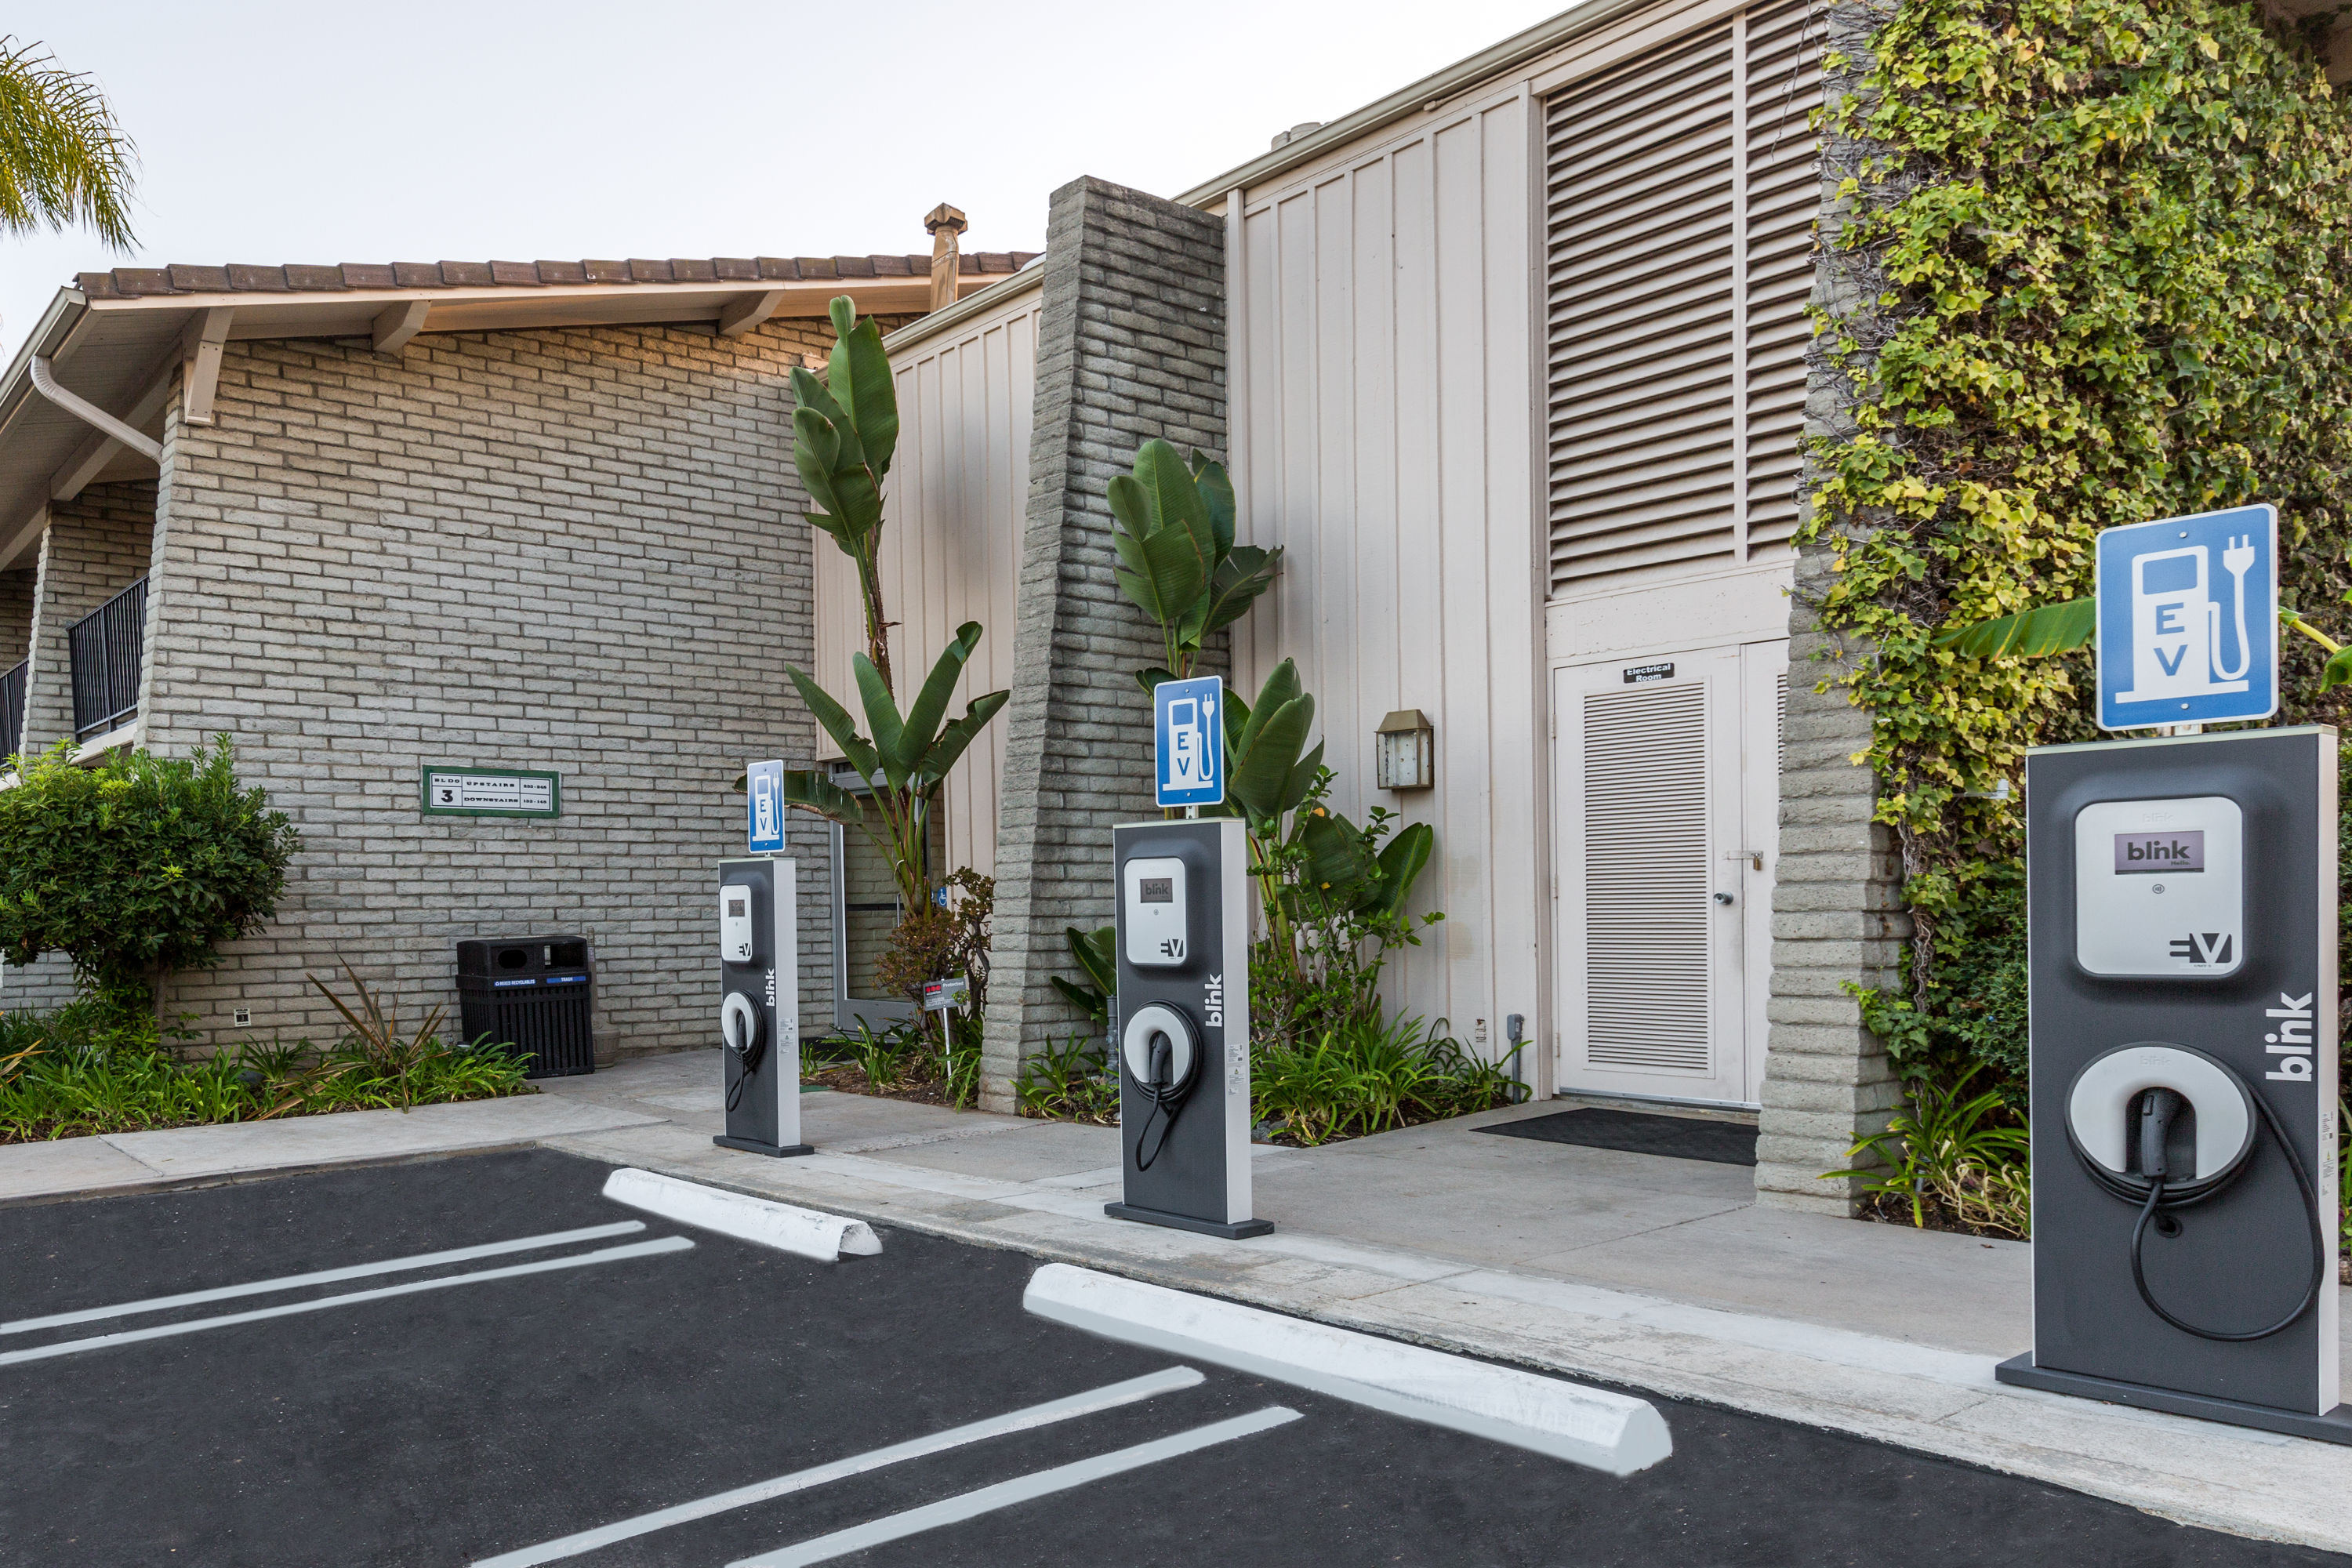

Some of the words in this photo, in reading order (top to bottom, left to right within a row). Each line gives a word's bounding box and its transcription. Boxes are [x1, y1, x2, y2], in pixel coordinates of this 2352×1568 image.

[2153, 602, 2188, 677] EV
[1627, 663, 1671, 676] Electrical
[1635, 673, 1662, 682] Room
[1177, 731, 1191, 776] EV
[441, 789, 454, 803] 3
[2127, 840, 2190, 861] blink
[1145, 883, 1169, 895] blink
[765, 968, 775, 1007] blink
[1204, 974, 1223, 1028] blink
[2264, 992, 2313, 1082] blink
